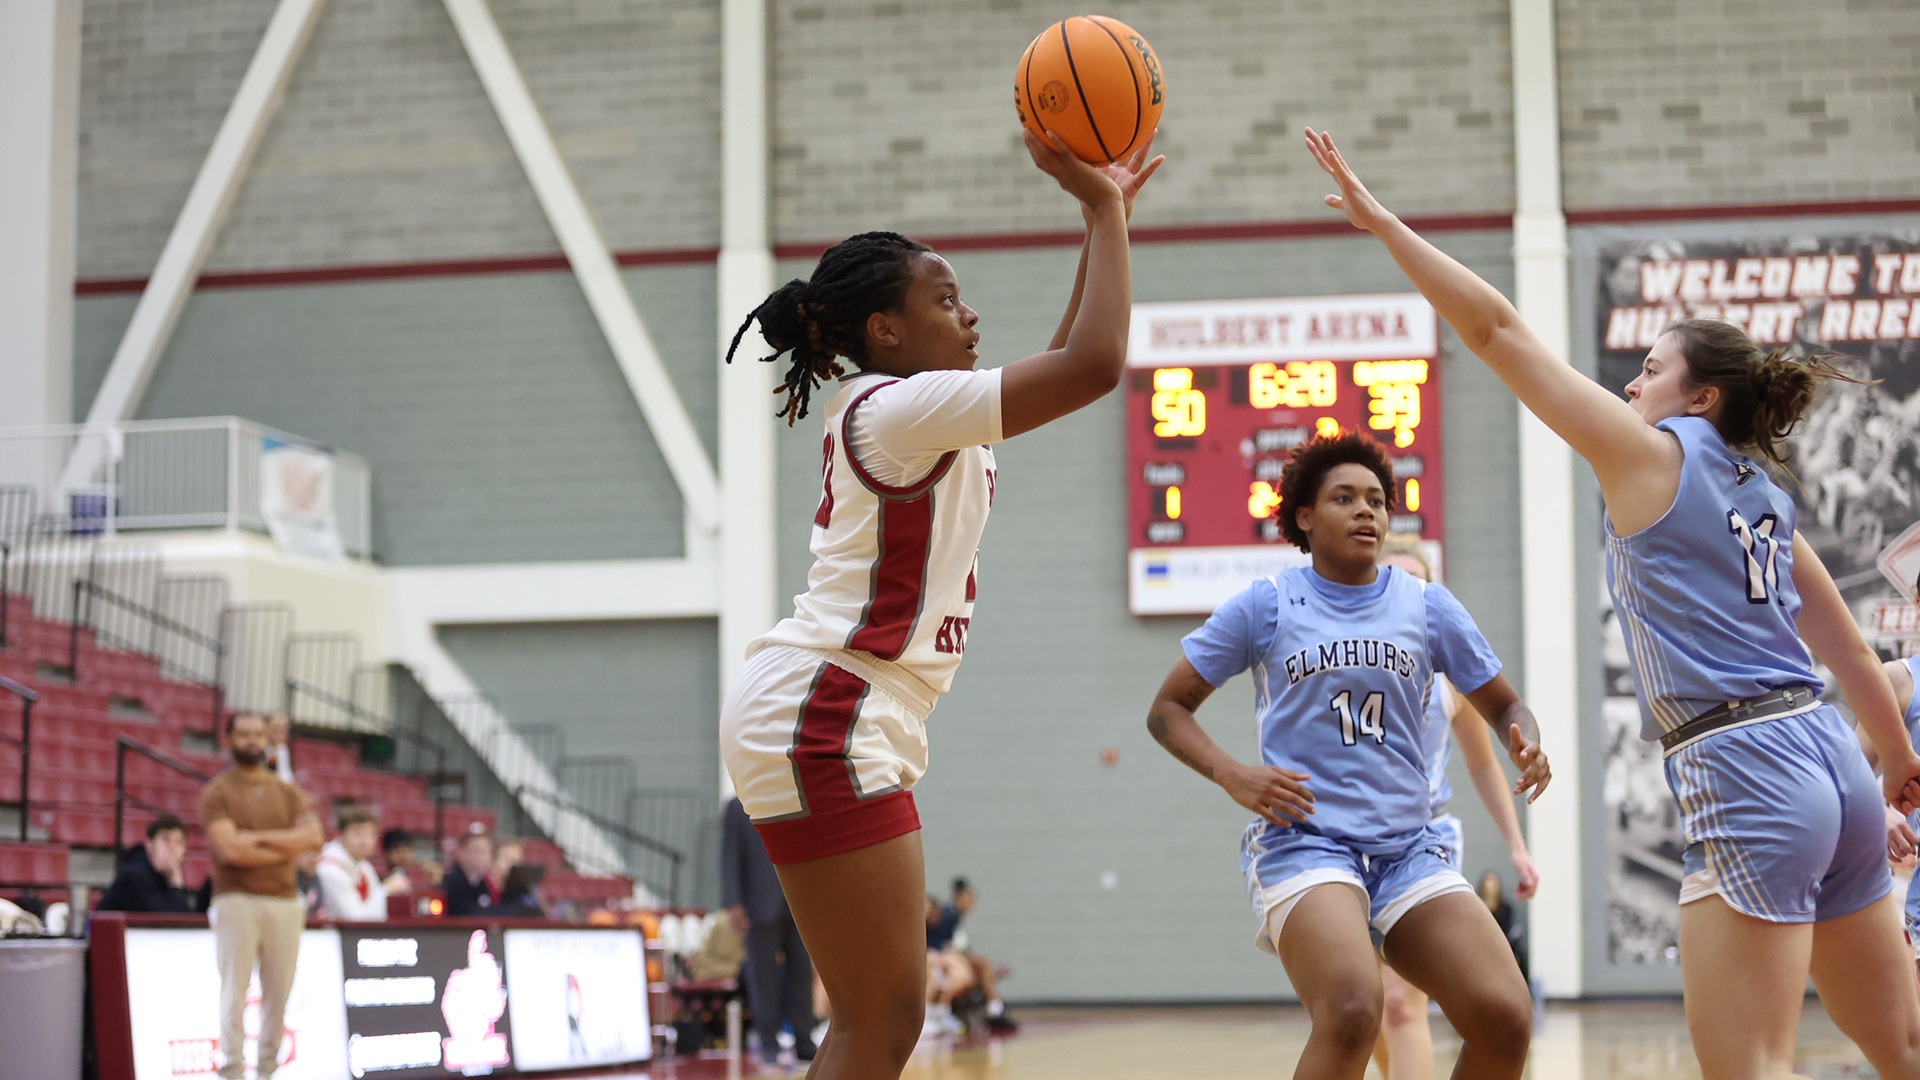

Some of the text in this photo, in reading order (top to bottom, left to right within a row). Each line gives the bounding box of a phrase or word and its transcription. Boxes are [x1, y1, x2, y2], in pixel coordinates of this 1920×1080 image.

[1642, 252, 1920, 302] WELCOME TO
[1305, 309, 1409, 342] ARENA
[1605, 302, 1804, 350] HUERT
[1152, 389, 1206, 437] 50
[1368, 382, 1421, 430] 39
[1726, 506, 1786, 605] 11
[1329, 689, 1386, 747] 14
